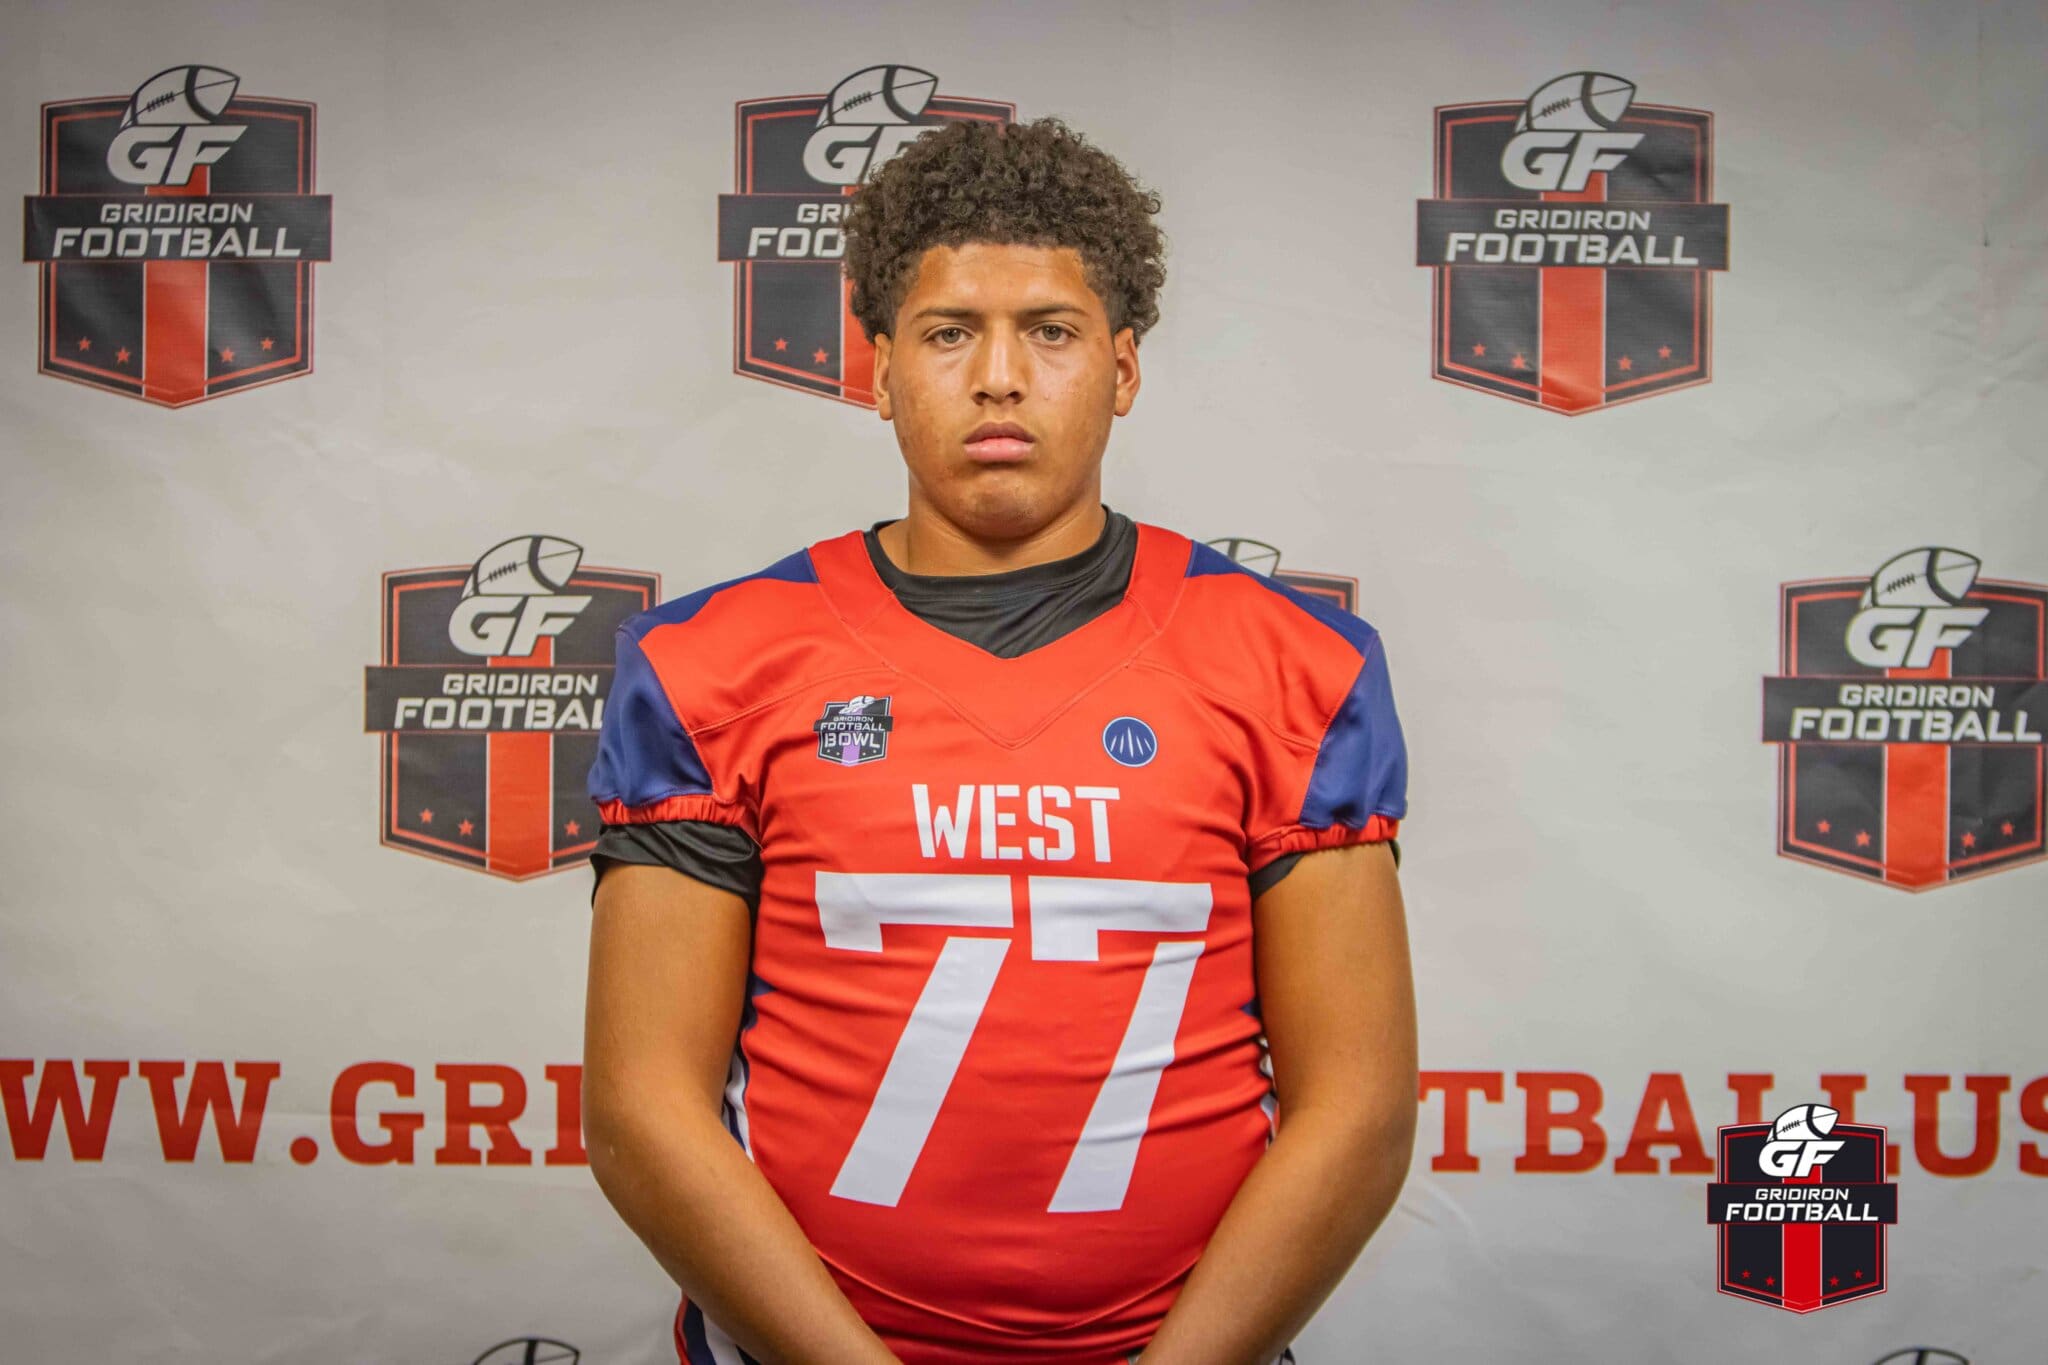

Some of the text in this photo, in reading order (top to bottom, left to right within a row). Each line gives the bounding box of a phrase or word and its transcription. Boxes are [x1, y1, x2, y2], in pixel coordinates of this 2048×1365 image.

[106, 125, 248, 186] GF
[1502, 131, 1646, 192] GF
[100, 203, 253, 224] GRIDIRON
[1495, 209, 1650, 231] GRIDIRON
[52, 227, 301, 258] FOOTBALL
[1446, 232, 1699, 265] FOOTBALL
[449, 595, 592, 656] GF
[1846, 607, 1990, 668] GF
[442, 673, 598, 695] GRIDIRON
[1839, 684, 1995, 708] GRIDIRON
[394, 698, 604, 730] FOOTBAL
[820, 721, 886, 732] FOOTBALL
[1790, 708, 2043, 742] FOOTBALL
[824, 732, 880, 748] BOWL
[912, 783, 1120, 862] WEST
[815, 871, 1213, 1213] 77
